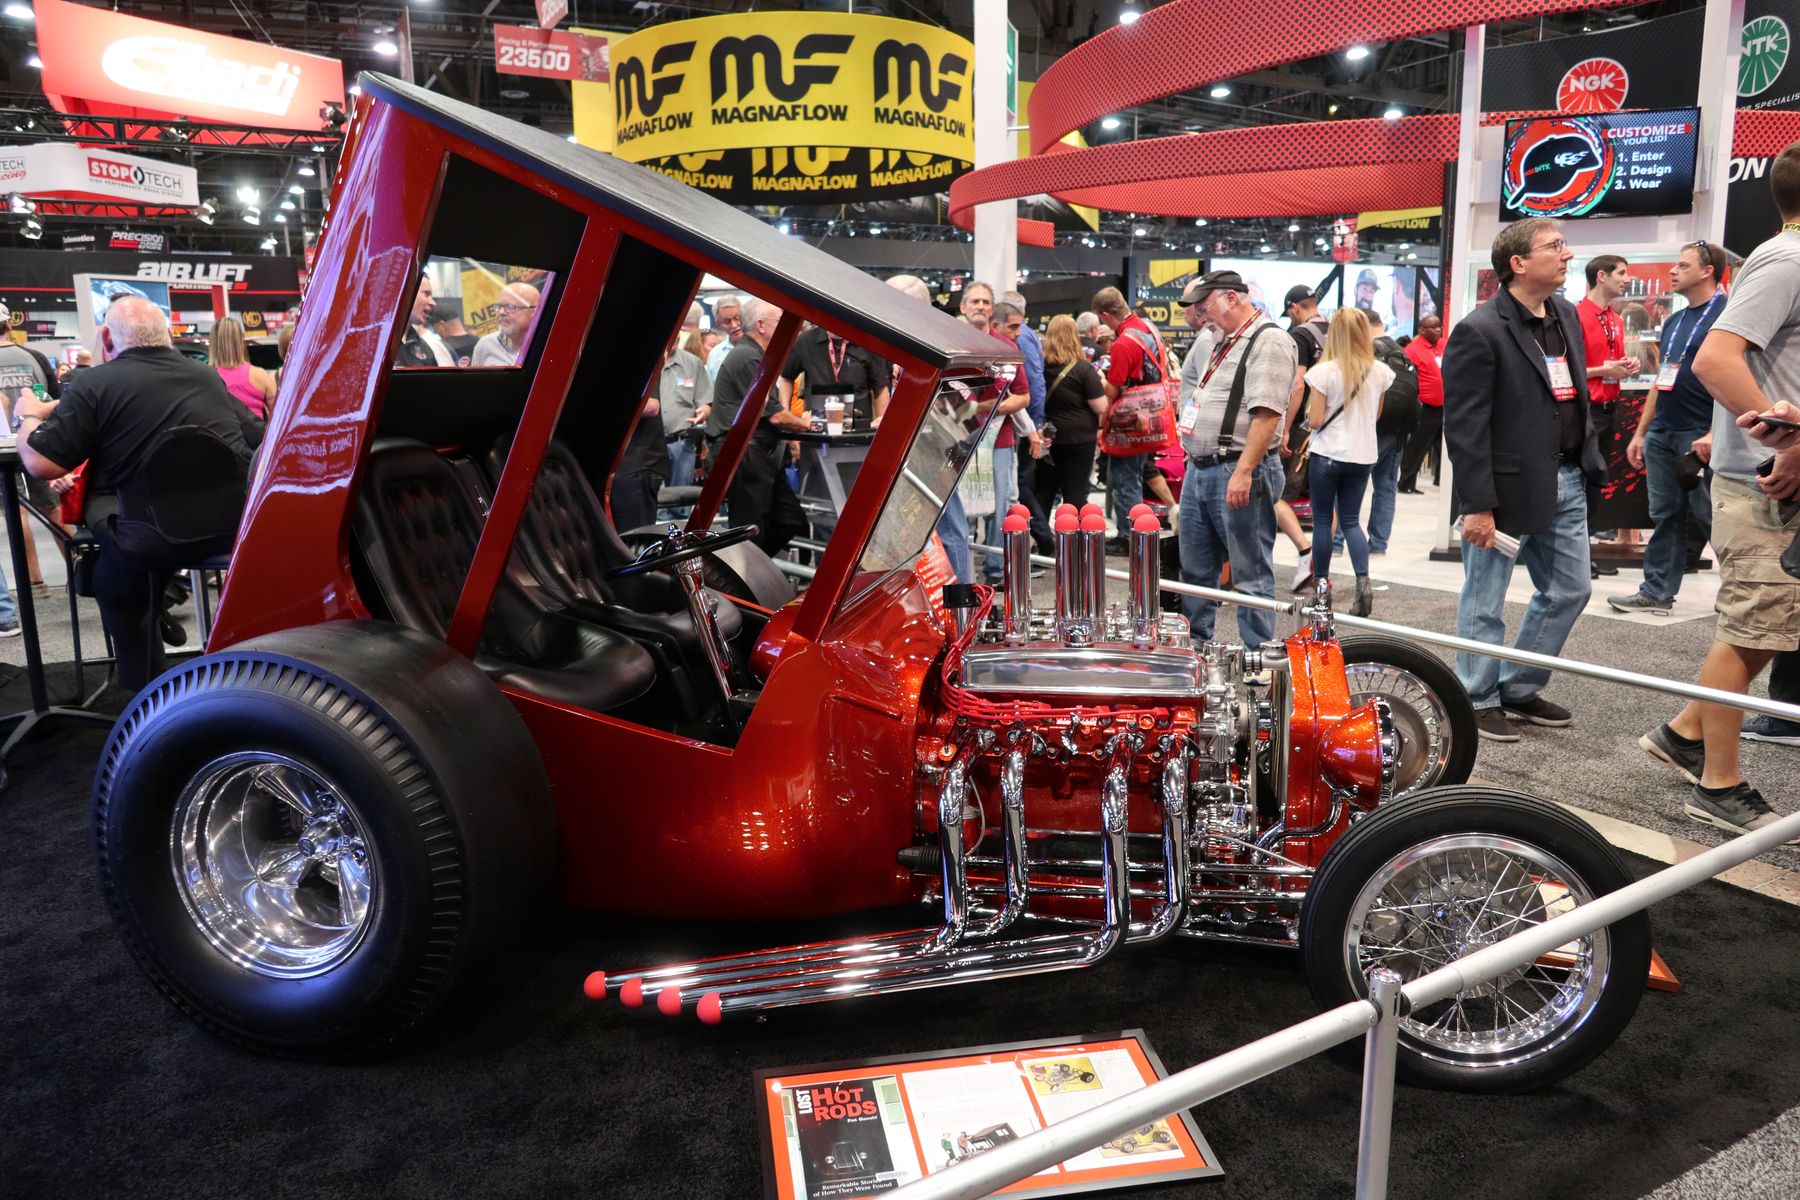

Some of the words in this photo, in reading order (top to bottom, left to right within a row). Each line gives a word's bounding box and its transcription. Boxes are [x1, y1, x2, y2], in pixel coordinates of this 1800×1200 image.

[499, 45, 571, 72] 23500
[1569, 71, 1617, 94] NGK
[711, 104, 847, 125] MAGNAFLOW
[874, 107, 965, 138] MAGNAFLOW
[617, 112, 693, 145] MAGNAFLOW
[1607, 124, 1685, 139] CUSTOMIZE
[1623, 138, 1648, 146] YOUR
[1632, 151, 1665, 162] Enter
[870, 161, 952, 187] MAGNAFLOW
[1631, 165, 1671, 177] Design
[752, 174, 857, 191] MAGNAFLOW
[1629, 179, 1661, 189] Wear
[194, 263, 252, 282] LIFT
[0, 374, 33, 388] ANS
[796, 1090, 813, 1114] LOST
[811, 1087, 864, 1107] HOT
[814, 1100, 877, 1121] RODS
[822, 1181, 859, 1190] Remarkable
[872, 1182, 892, 1190] Found
